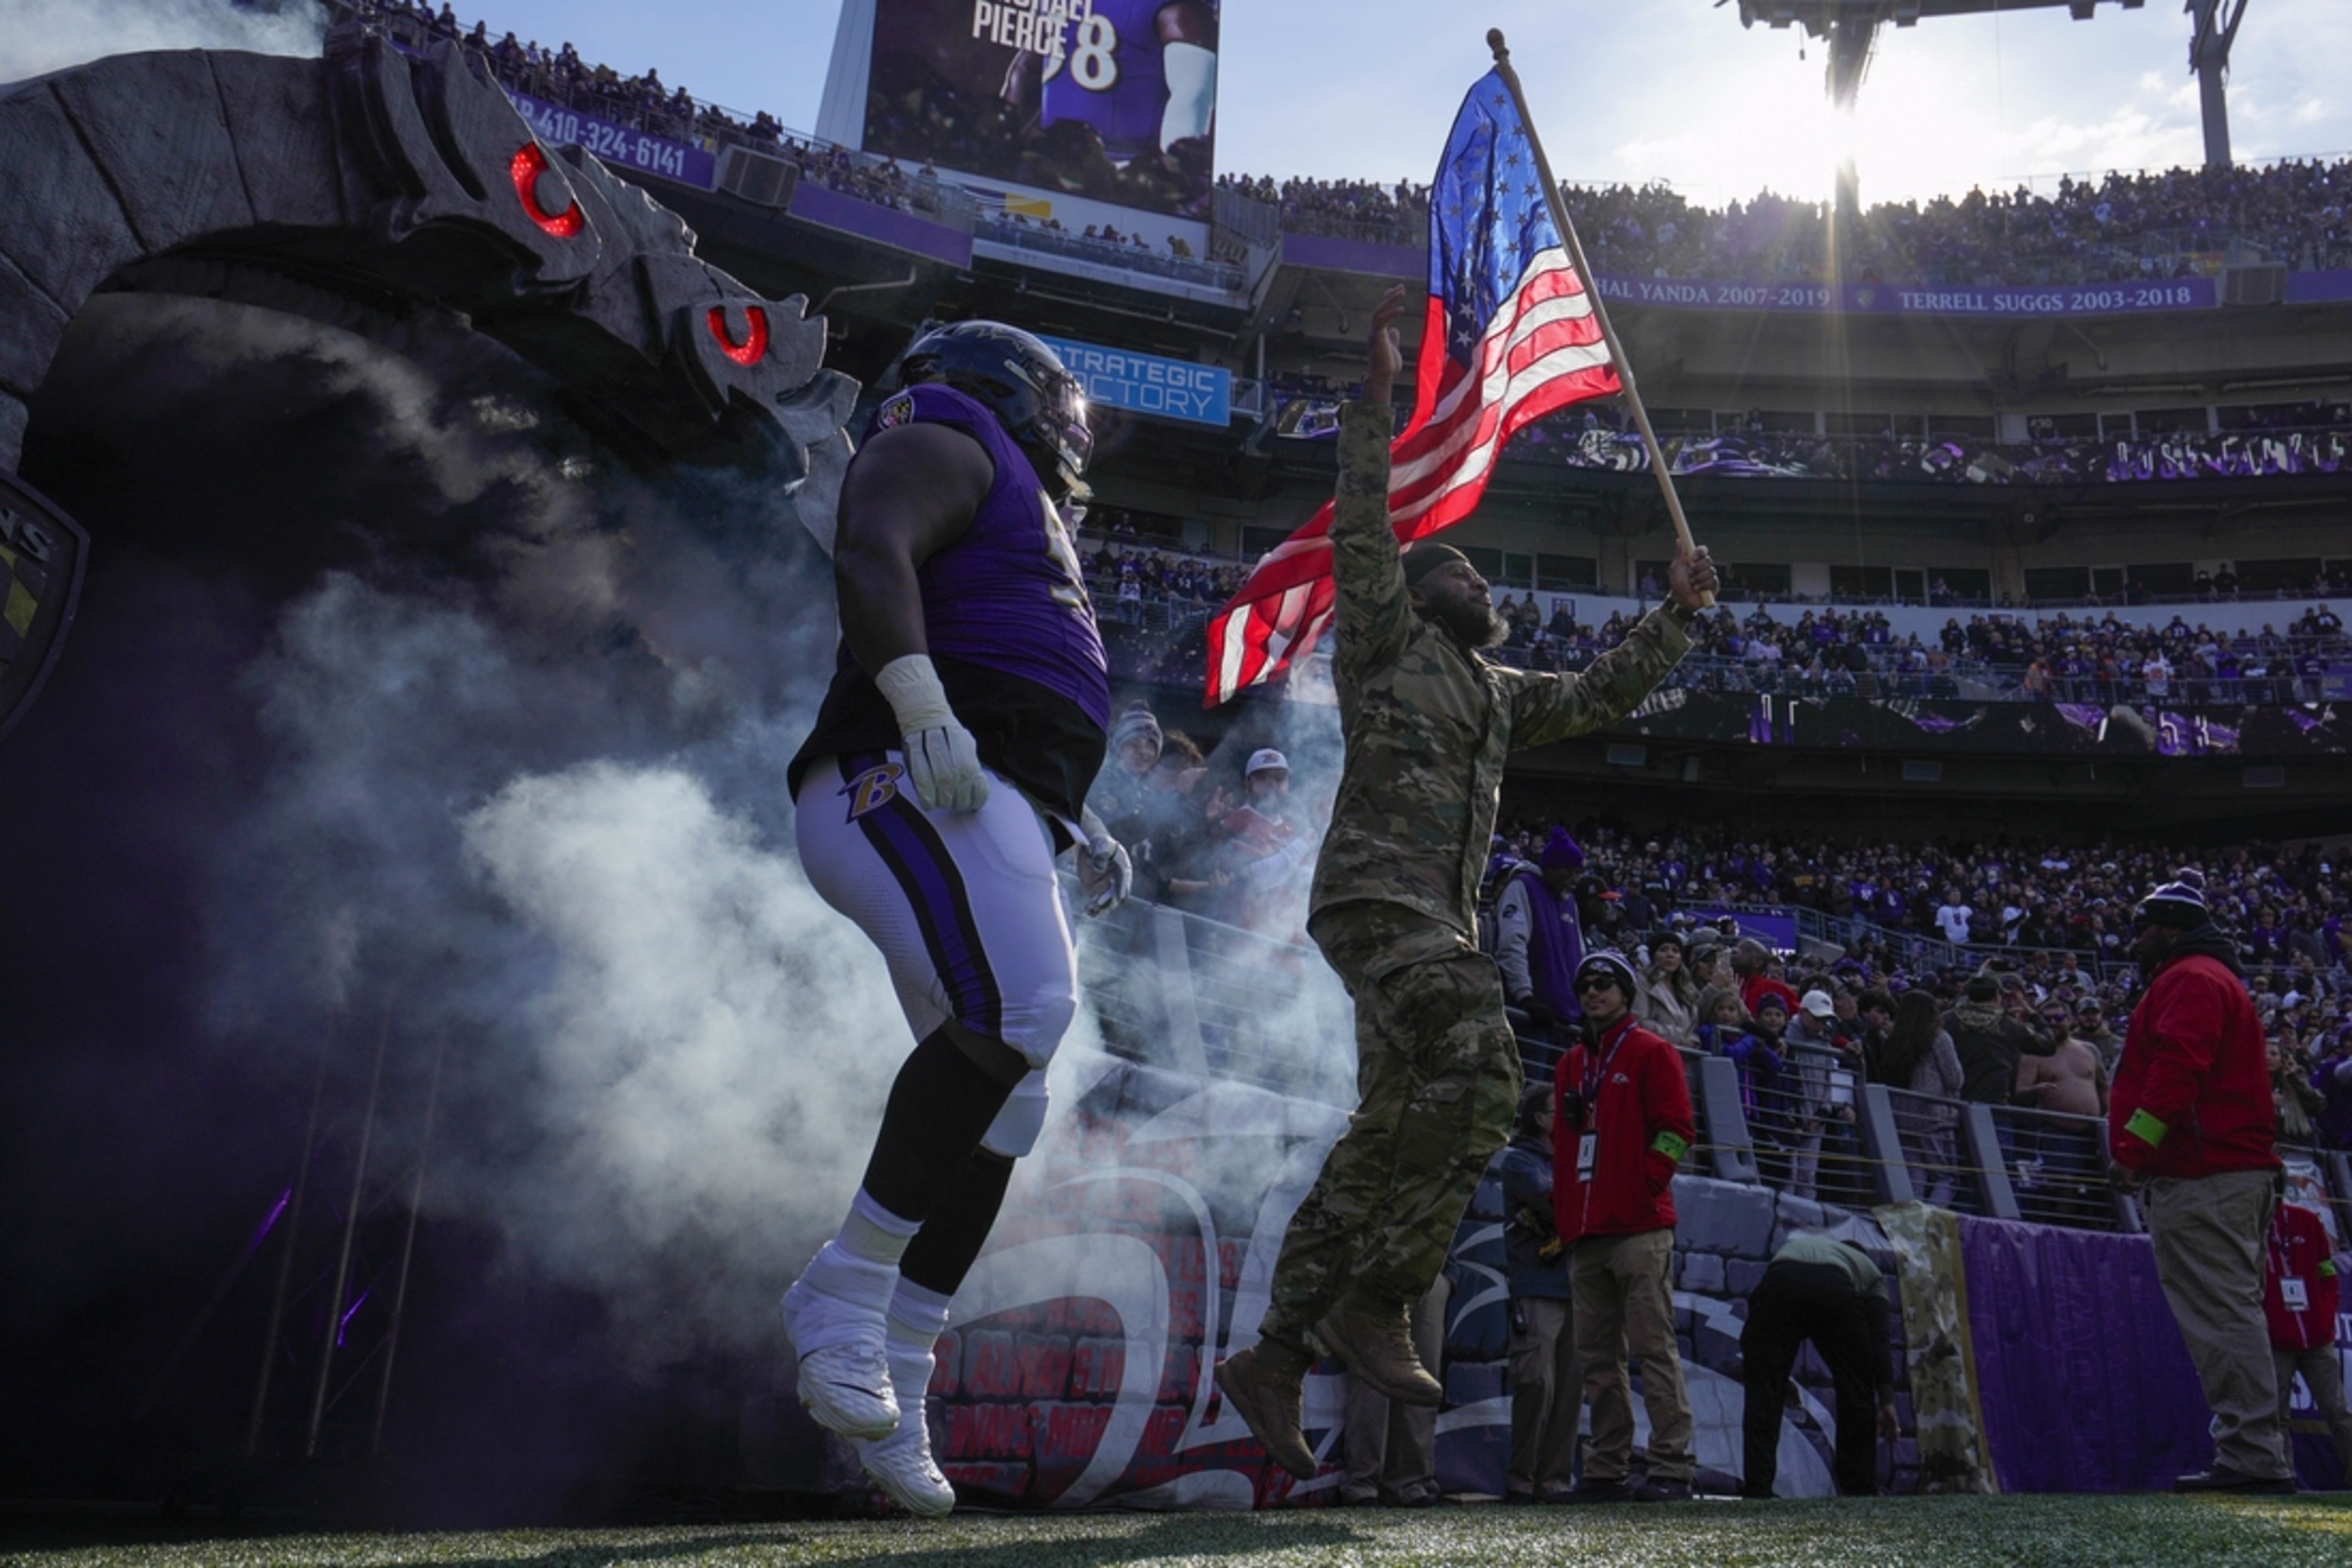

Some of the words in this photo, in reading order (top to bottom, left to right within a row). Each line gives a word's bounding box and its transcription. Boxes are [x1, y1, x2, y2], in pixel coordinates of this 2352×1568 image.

[972, 1, 1069, 59] PIERCE
[538, 108, 685, 177] 410-324-6141
[1639, 284, 1709, 304] YANDA
[1718, 286, 1831, 307] 2007-2019
[1899, 292, 1989, 310] TERRELL
[1994, 294, 2063, 311] SUGGS
[2071, 287, 2191, 310] 2003-2018
